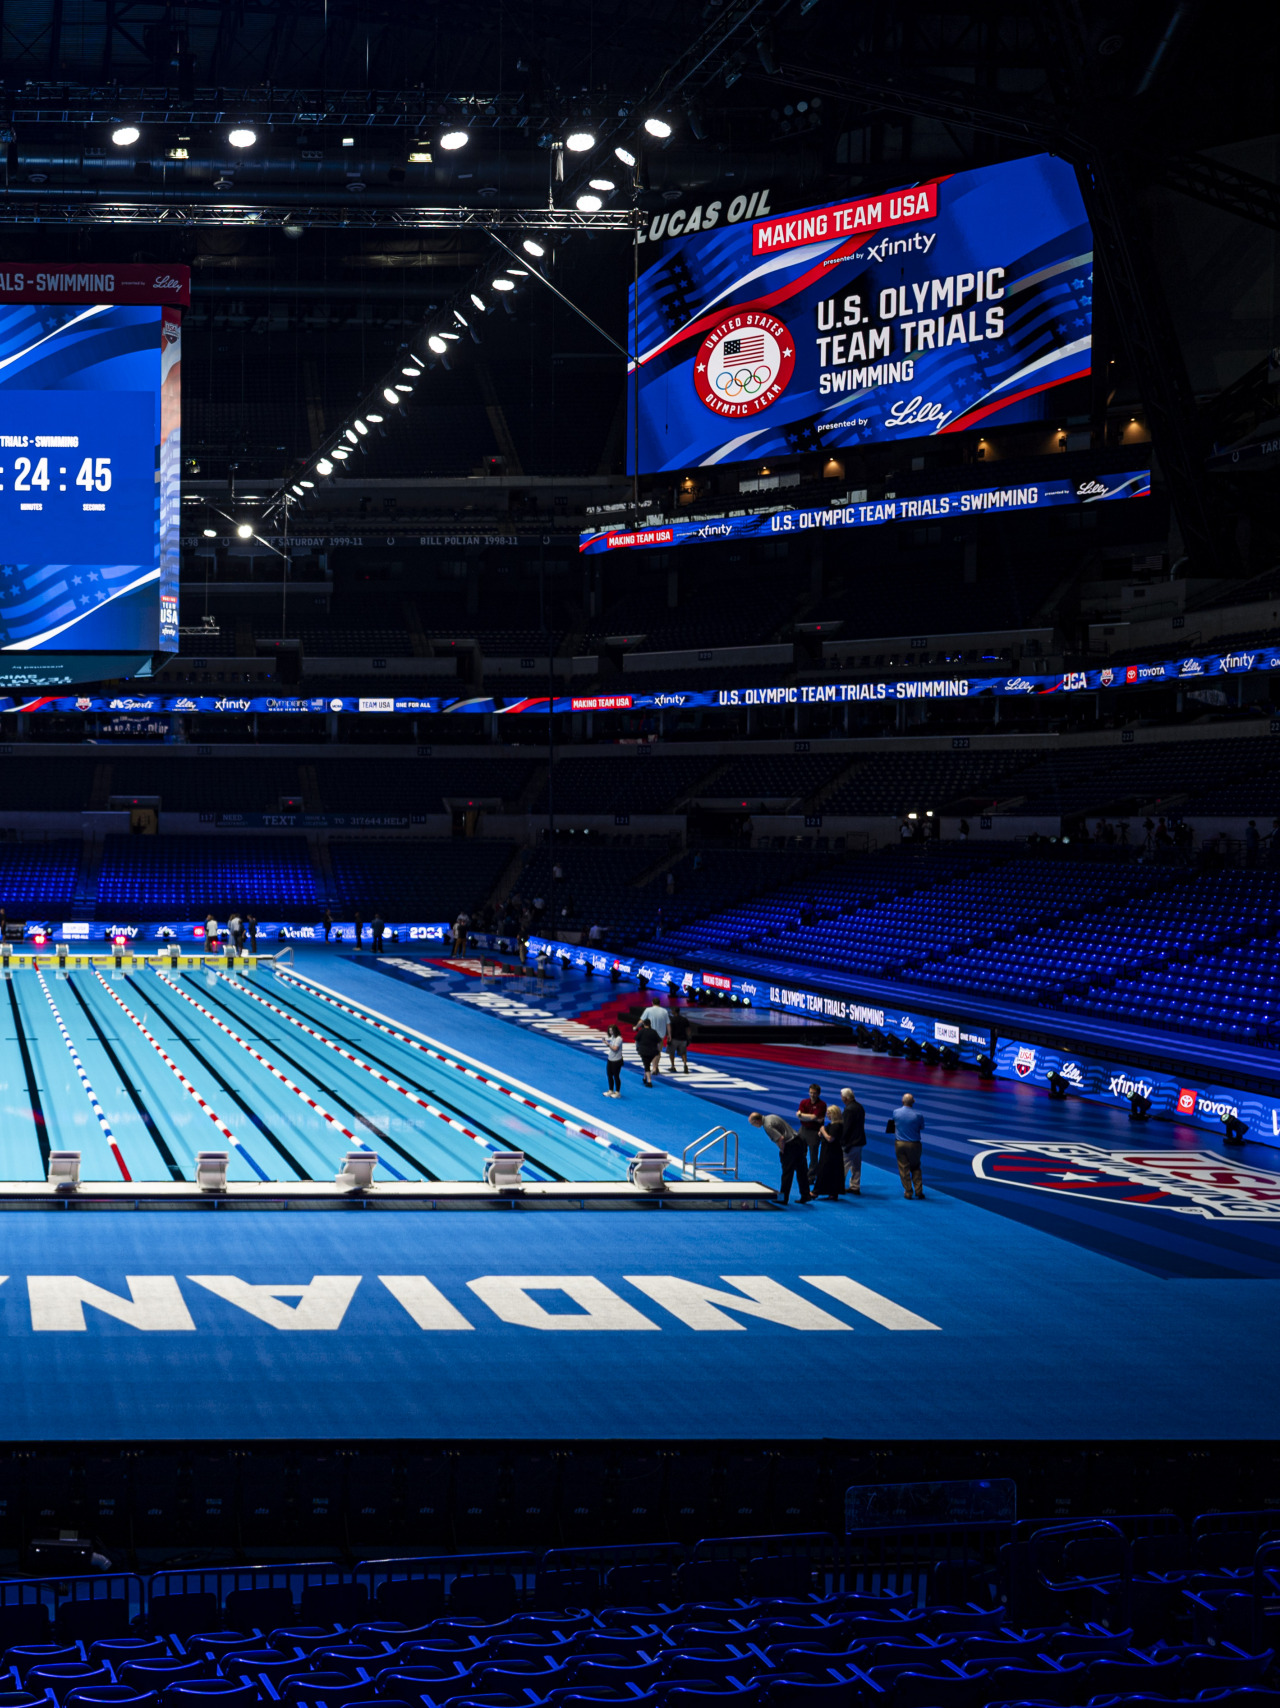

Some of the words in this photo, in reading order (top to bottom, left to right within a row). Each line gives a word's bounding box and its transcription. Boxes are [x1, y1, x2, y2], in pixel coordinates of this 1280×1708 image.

[727, 189, 771, 223] OIL
[757, 215, 828, 250] MAKING
[832, 205, 883, 232] TEAM
[889, 192, 930, 220] USA
[823, 254, 853, 267] presented
[854, 252, 865, 263] by
[867, 232, 937, 263] xfinity
[36, 273, 115, 293] SWIMMING
[152, 275, 183, 293] Lilly
[818, 295, 869, 331] U.S.
[879, 267, 1005, 319] OLYMPIC
[705, 317, 743, 350] UNITED
[745, 314, 786, 337] STATES
[816, 325, 891, 367] TEAM
[901, 306, 1004, 354] TRIALS
[819, 360, 914, 394] SWIMMING
[704, 392, 749, 415] OLYMPIC
[752, 383, 782, 412] TEAM
[817, 419, 855, 433] presented
[857, 417, 868, 428] by
[884, 395, 953, 428] Lilly
[0, 436, 28, 447] TRIALS
[35, 436, 79, 448] SWIMMING
[14, 458, 49, 492] 24
[76, 458, 112, 492] 45
[608, 533, 635, 547] MAKING
[636, 532, 655, 544] TEAM
[655, 531, 671, 542] USA
[698, 524, 732, 538] xfinity
[771, 514, 796, 532] U.S.
[799, 508, 855, 529] OLYMPIC
[859, 503, 896, 523] TEAM
[900, 497, 950, 518] TRIALS
[960, 487, 1038, 512] SWIMMING
[1076, 480, 1109, 496] Lilly
[278, 538, 324, 546] SATURDAY
[329, 538, 363, 546] 1999-11
[420, 537, 441, 545] BILL
[444, 537, 480, 545] POLIAN
[484, 537, 518, 545] 1998-11
[160, 608, 179, 626] USA
[573, 698, 597, 709] MAKING
[598, 698, 615, 708] TEAM
[615, 697, 630, 707] USA
[654, 694, 685, 706] xfinity
[719, 689, 741, 706] U.S.
[745, 686, 797, 705] OLYMPIC
[801, 685, 836, 702] TEAM
[840, 683, 886, 701] TRIALS
[896, 679, 968, 698] SWIMMING
[1004, 678, 1034, 694] Lilly
[1139, 667, 1165, 678] TOYOTA
[1182, 659, 1202, 673] Lilly
[1219, 653, 1255, 673] xfinity
[214, 698, 251, 711] xfinity
[362, 701, 377, 709] TEAM
[378, 701, 391, 709] USA
[262, 815, 297, 826] TEXT
[770, 987, 781, 1004] U.S.
[781, 989, 805, 1009] OLYMPIC
[806, 994, 823, 1012] TEAM
[823, 998, 846, 1019] TRIALS
[850, 1004, 884, 1027] SWIMMING
[900, 1016, 916, 1034] Lilly
[937, 1026, 947, 1036] TEAM
[948, 1029, 956, 1038] USA
[1019, 1050, 1033, 1061] USA
[1060, 1062, 1083, 1083] Lilly
[1108, 1074, 1153, 1099] xfinity
[1199, 1098, 1238, 1119] TOYOTA
